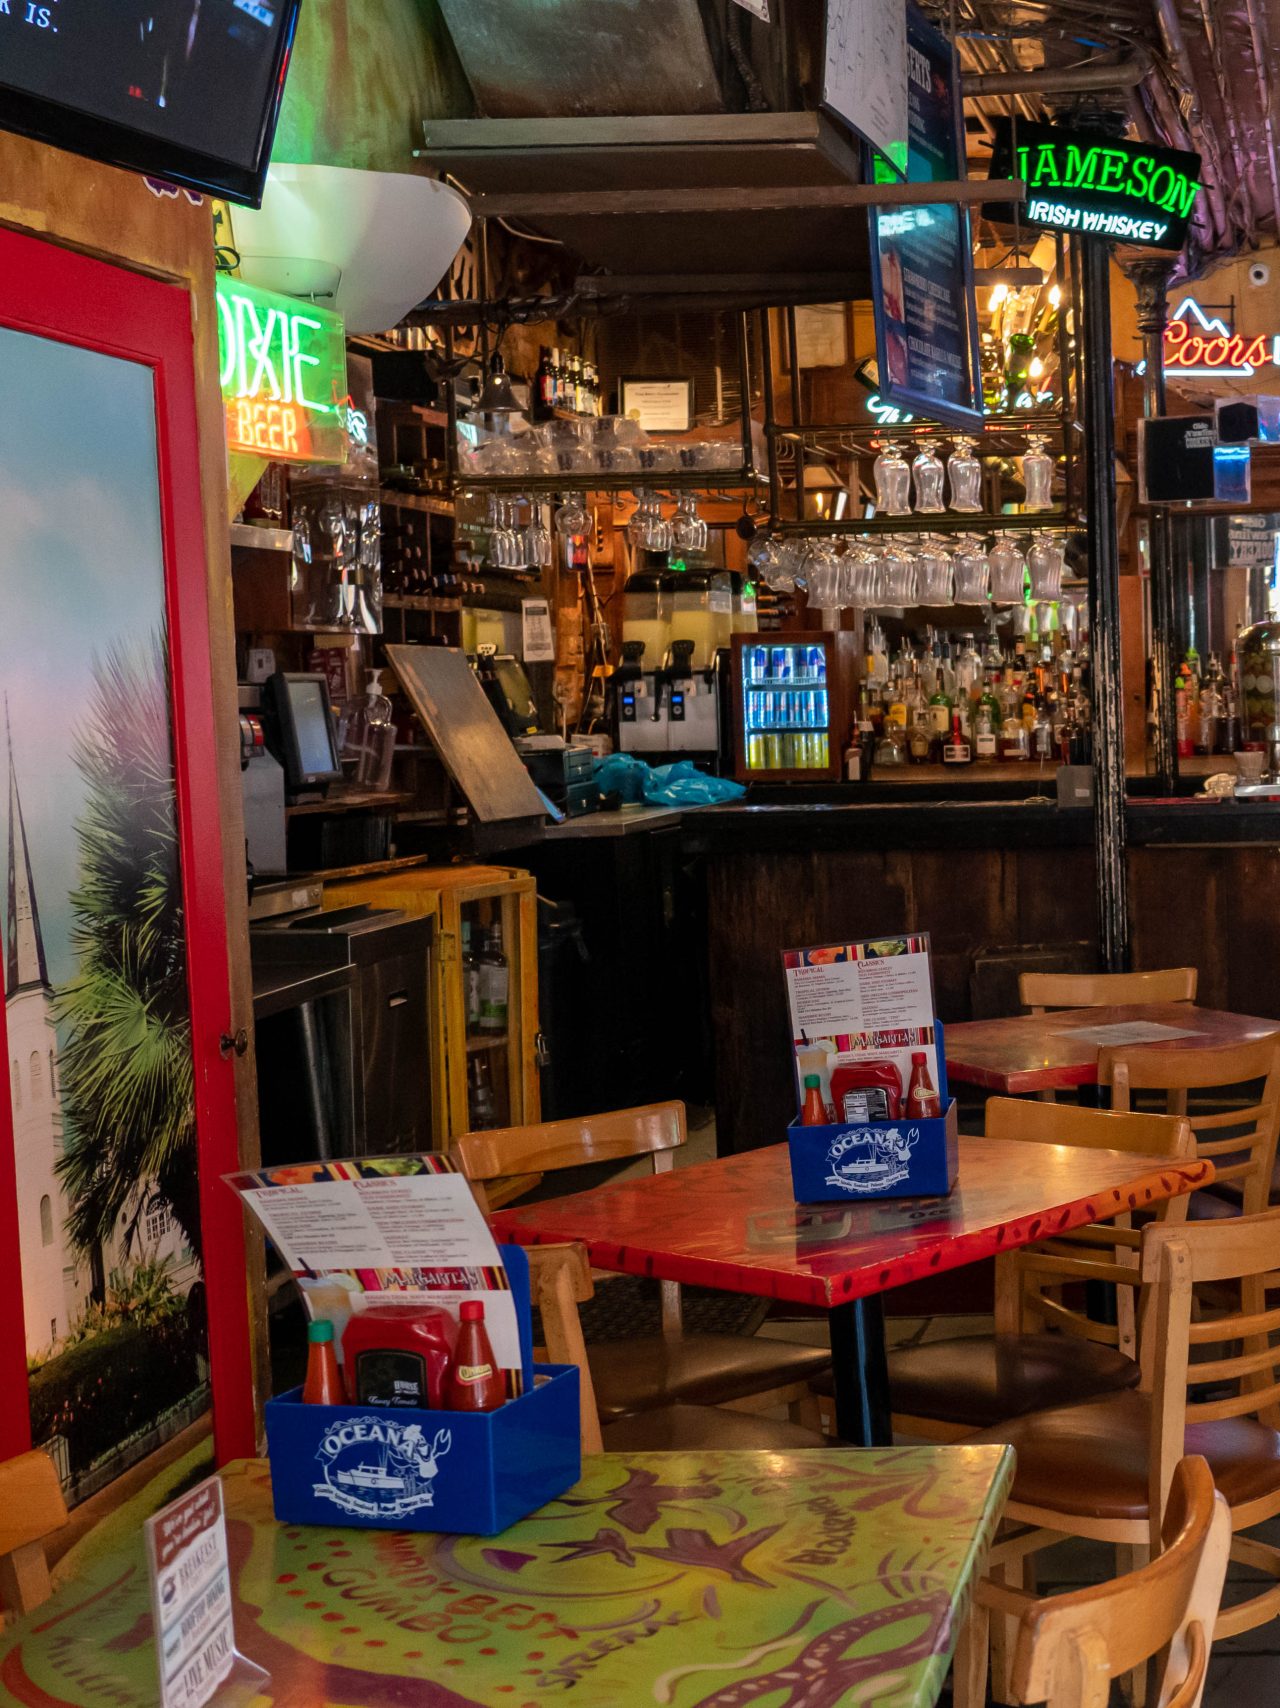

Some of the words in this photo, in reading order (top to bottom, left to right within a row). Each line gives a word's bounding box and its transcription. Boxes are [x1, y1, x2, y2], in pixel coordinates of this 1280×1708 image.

[1008, 144, 1201, 218] JAMESON
[1028, 200, 1080, 228] IRISH
[1083, 211, 1168, 241] WHISKEY
[1164, 320, 1273, 368] Coors
[237, 401, 298, 453] BEER
[851, 1032, 916, 1049] MARGARITAS
[831, 1132, 893, 1157] OCEANA
[384, 1272, 479, 1290] MARGARITAS
[324, 1424, 415, 1458] OCEANA
[178, 1532, 218, 1585] BREAKFAST
[322, 1567, 493, 1643] GUMBO
[444, 1593, 580, 1641] BEST
[184, 1662, 203, 1691] LIVE
[203, 1626, 231, 1671] MUSIC
